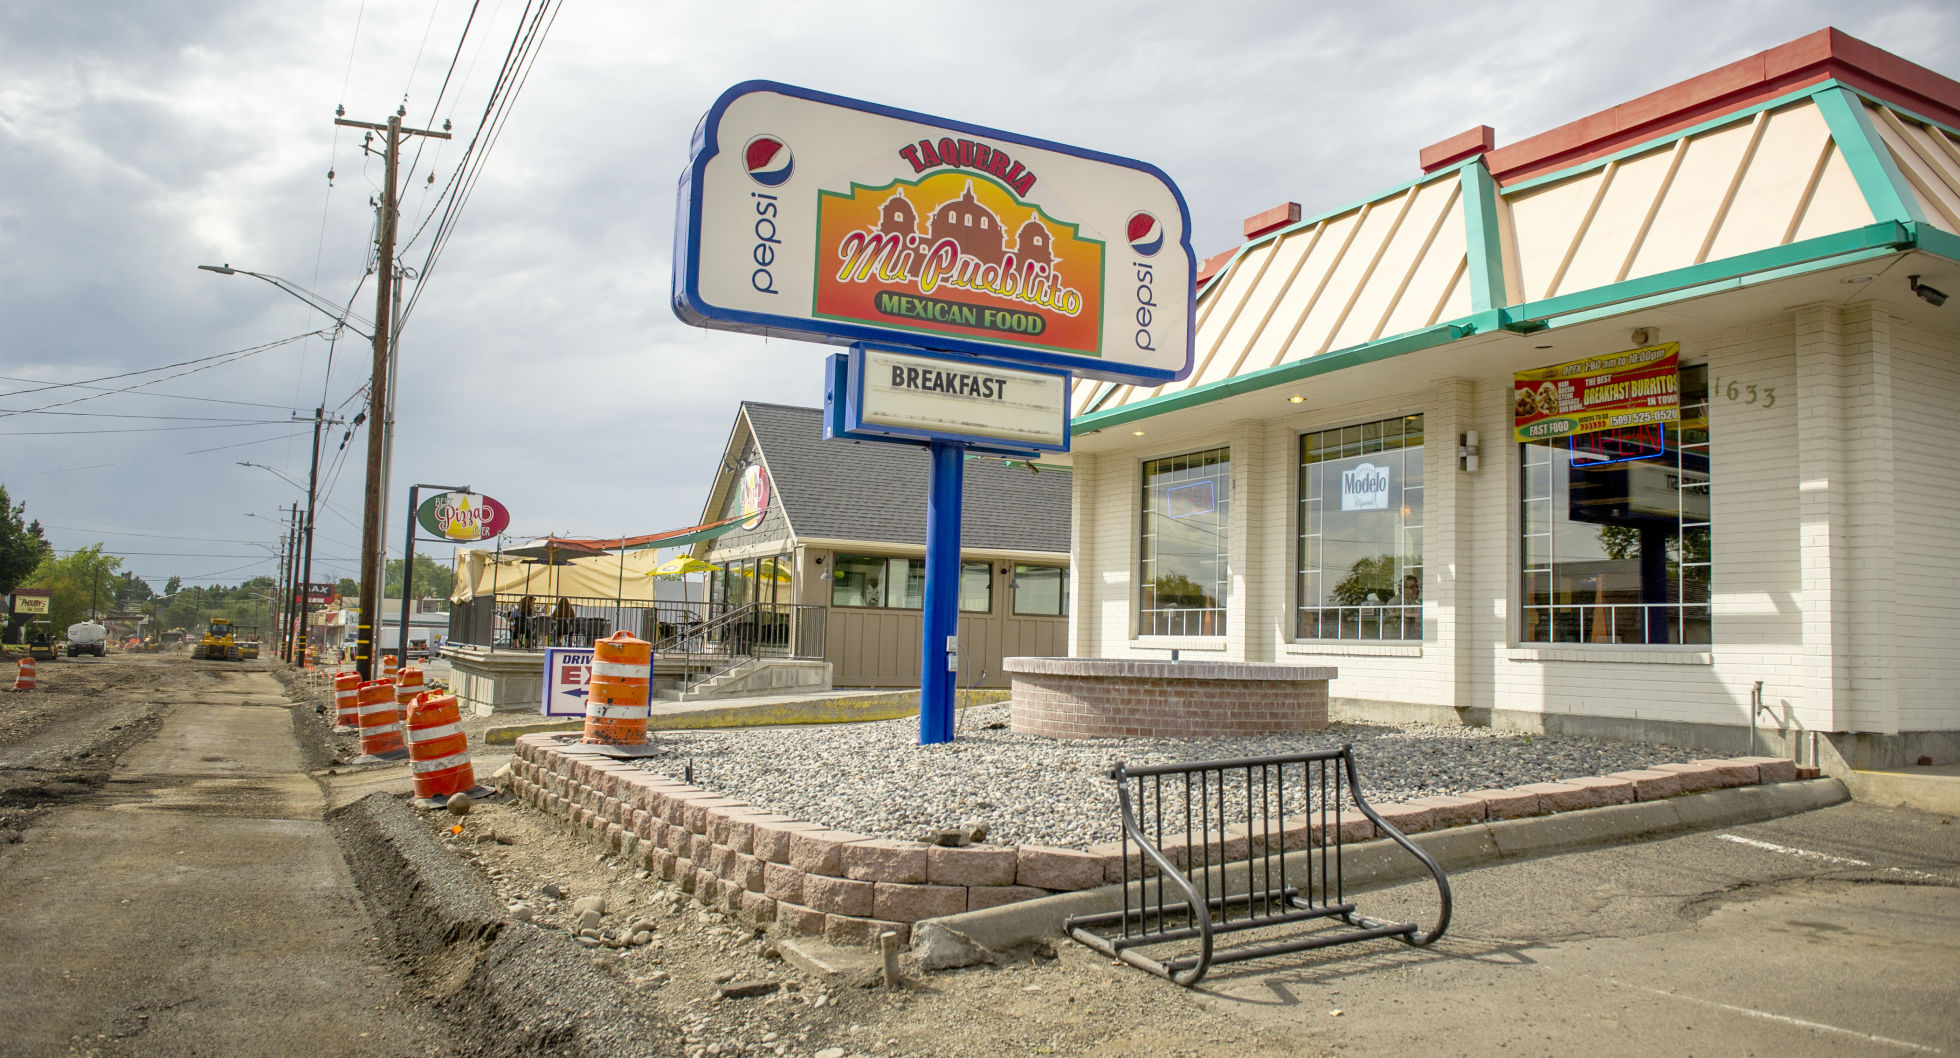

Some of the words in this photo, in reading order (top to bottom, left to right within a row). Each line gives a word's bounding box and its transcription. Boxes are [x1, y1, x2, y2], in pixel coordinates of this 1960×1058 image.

[899, 137, 1037, 198] TAQUERIA
[751, 192, 782, 294] pepsi
[837, 230, 918, 283] Mi
[918, 238, 1082, 317] Pueblito
[881, 293, 976, 326] MEXICAN
[984, 309, 1043, 334] FOOD
[1133, 262, 1157, 352] pepsi
[1562, 364, 1582, 376] OPEN
[1617, 356, 1627, 366] to
[1585, 378, 1597, 386] THE
[1597, 374, 1611, 384] BEST
[891, 365, 1007, 400] BREAKFAST
[1583, 381, 1630, 405] BREAKFAST
[1631, 374, 1678, 398] BURRITOS
[1714, 376, 1776, 408] 1633
[1647, 397, 1657, 406] IN
[1530, 424, 1548, 436] FAST
[1549, 420, 1569, 433] FOOD
[1610, 414, 1631, 427] (509)
[1632, 409, 1677, 424] 525-0520
[1573, 424, 1661, 463] OPEN
[1344, 472, 1386, 495] Modelo
[434, 504, 495, 532] Pizza
[562, 655, 594, 665] DRIV
